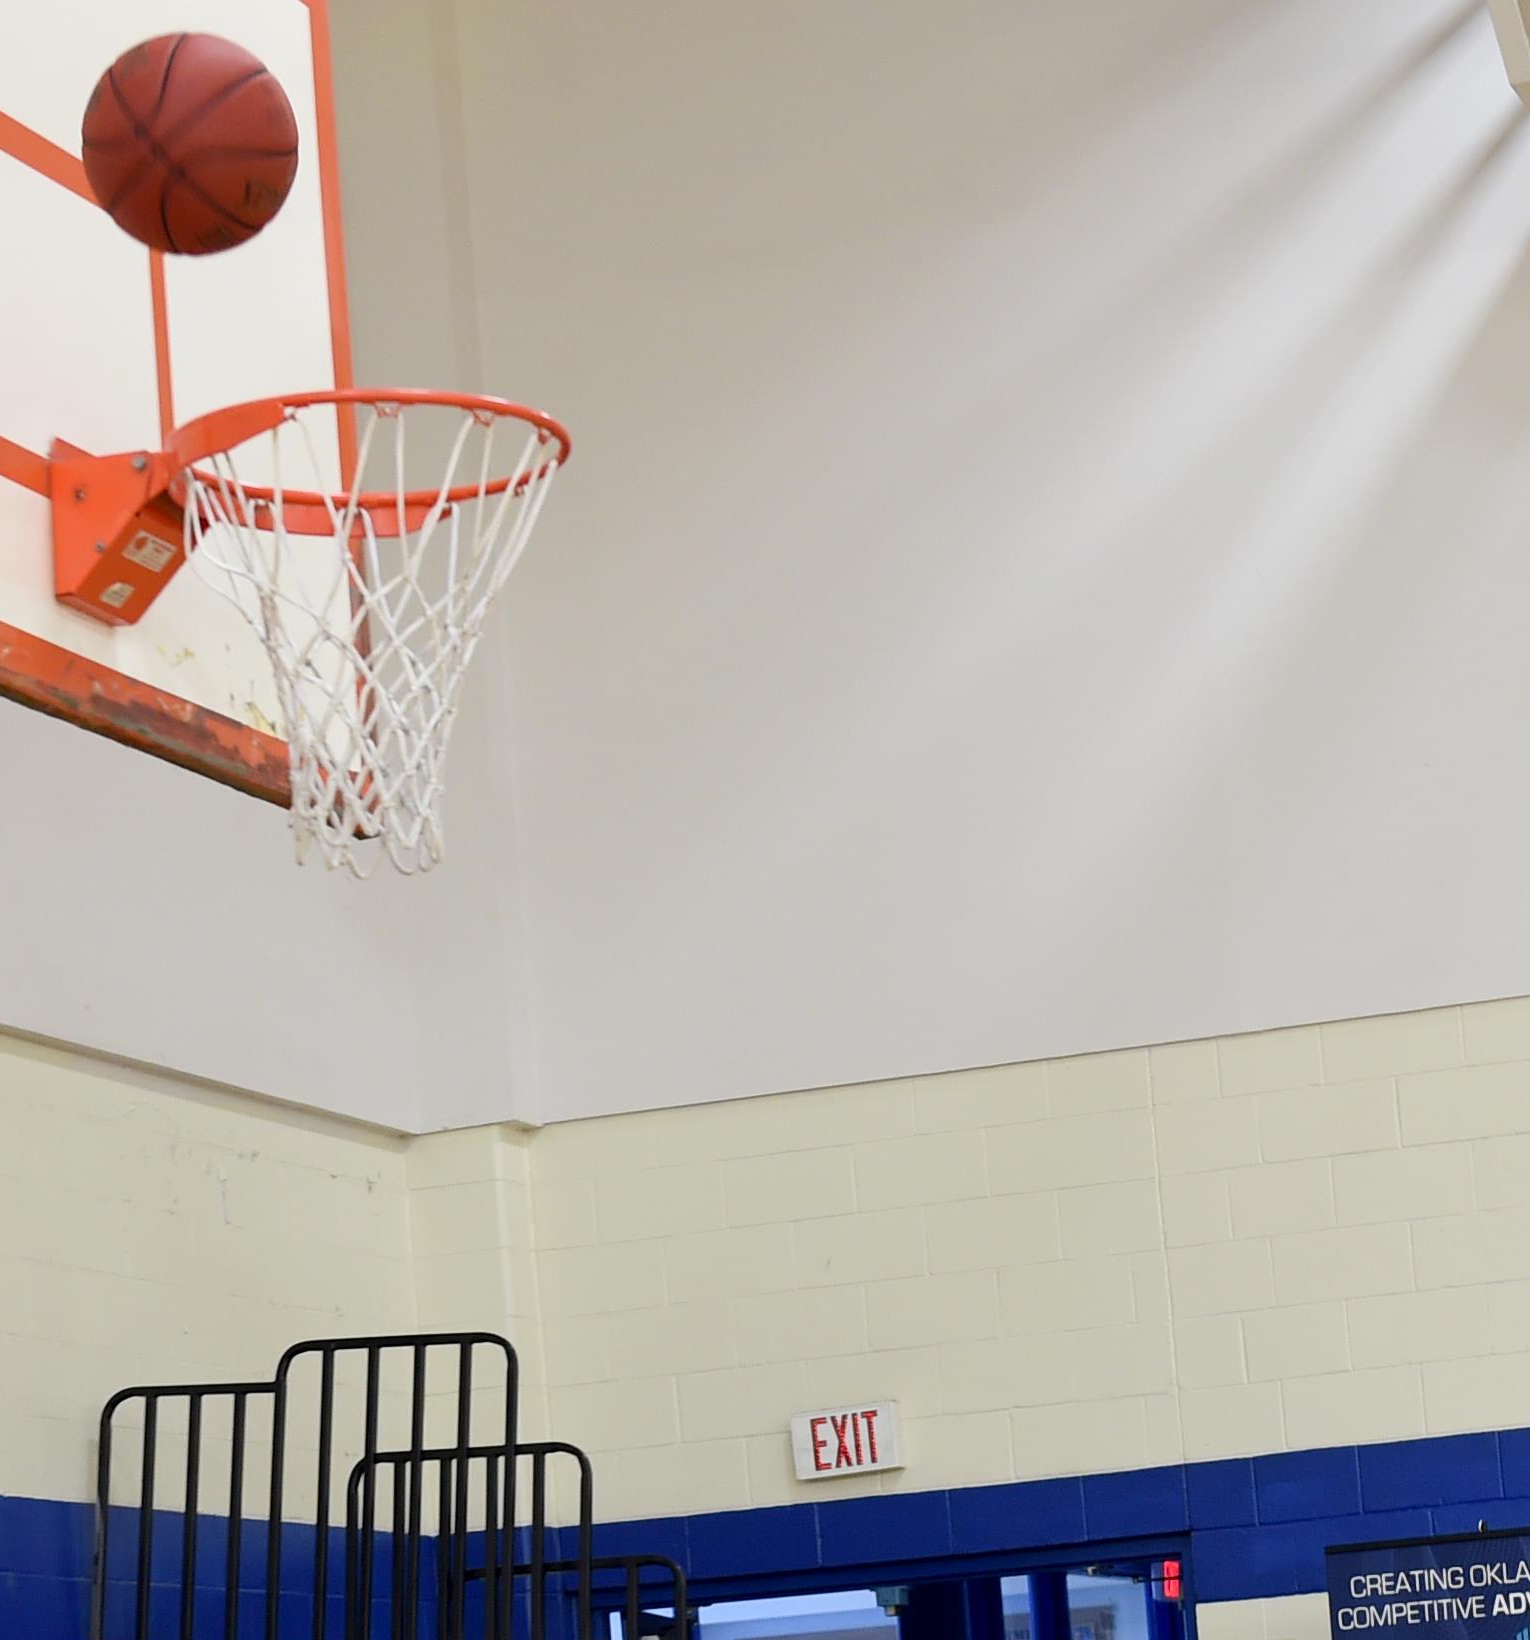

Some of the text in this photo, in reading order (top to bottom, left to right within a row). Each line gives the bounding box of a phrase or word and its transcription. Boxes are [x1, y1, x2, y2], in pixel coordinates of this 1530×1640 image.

[810, 1409, 878, 1471] EXIT
[1349, 1565, 1465, 1599] CREATING
[1337, 1595, 1487, 1631] COMPETITIVE
